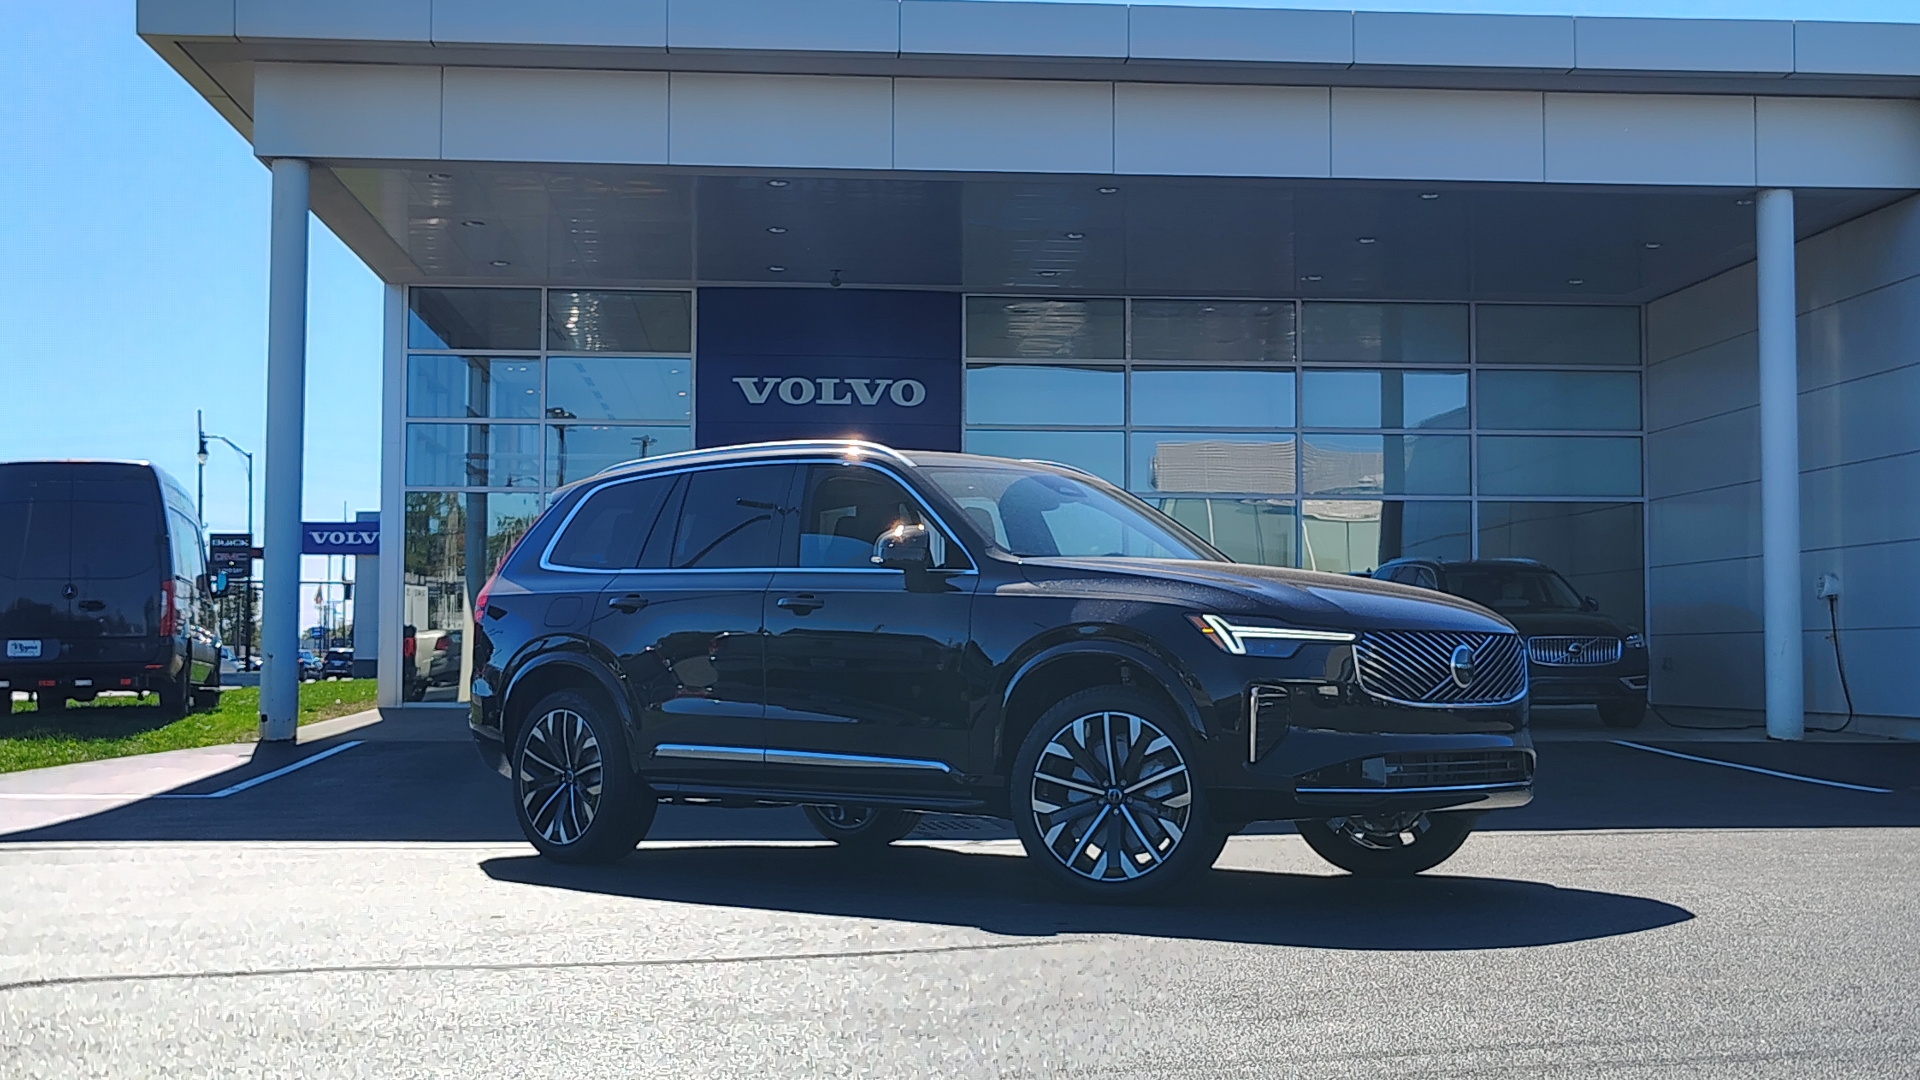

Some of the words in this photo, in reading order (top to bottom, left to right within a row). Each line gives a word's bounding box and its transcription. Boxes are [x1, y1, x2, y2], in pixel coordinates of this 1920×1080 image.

[732, 377, 926, 407] VOLVO
[212, 538, 249, 546] BUICK
[308, 531, 380, 545] VOLV
